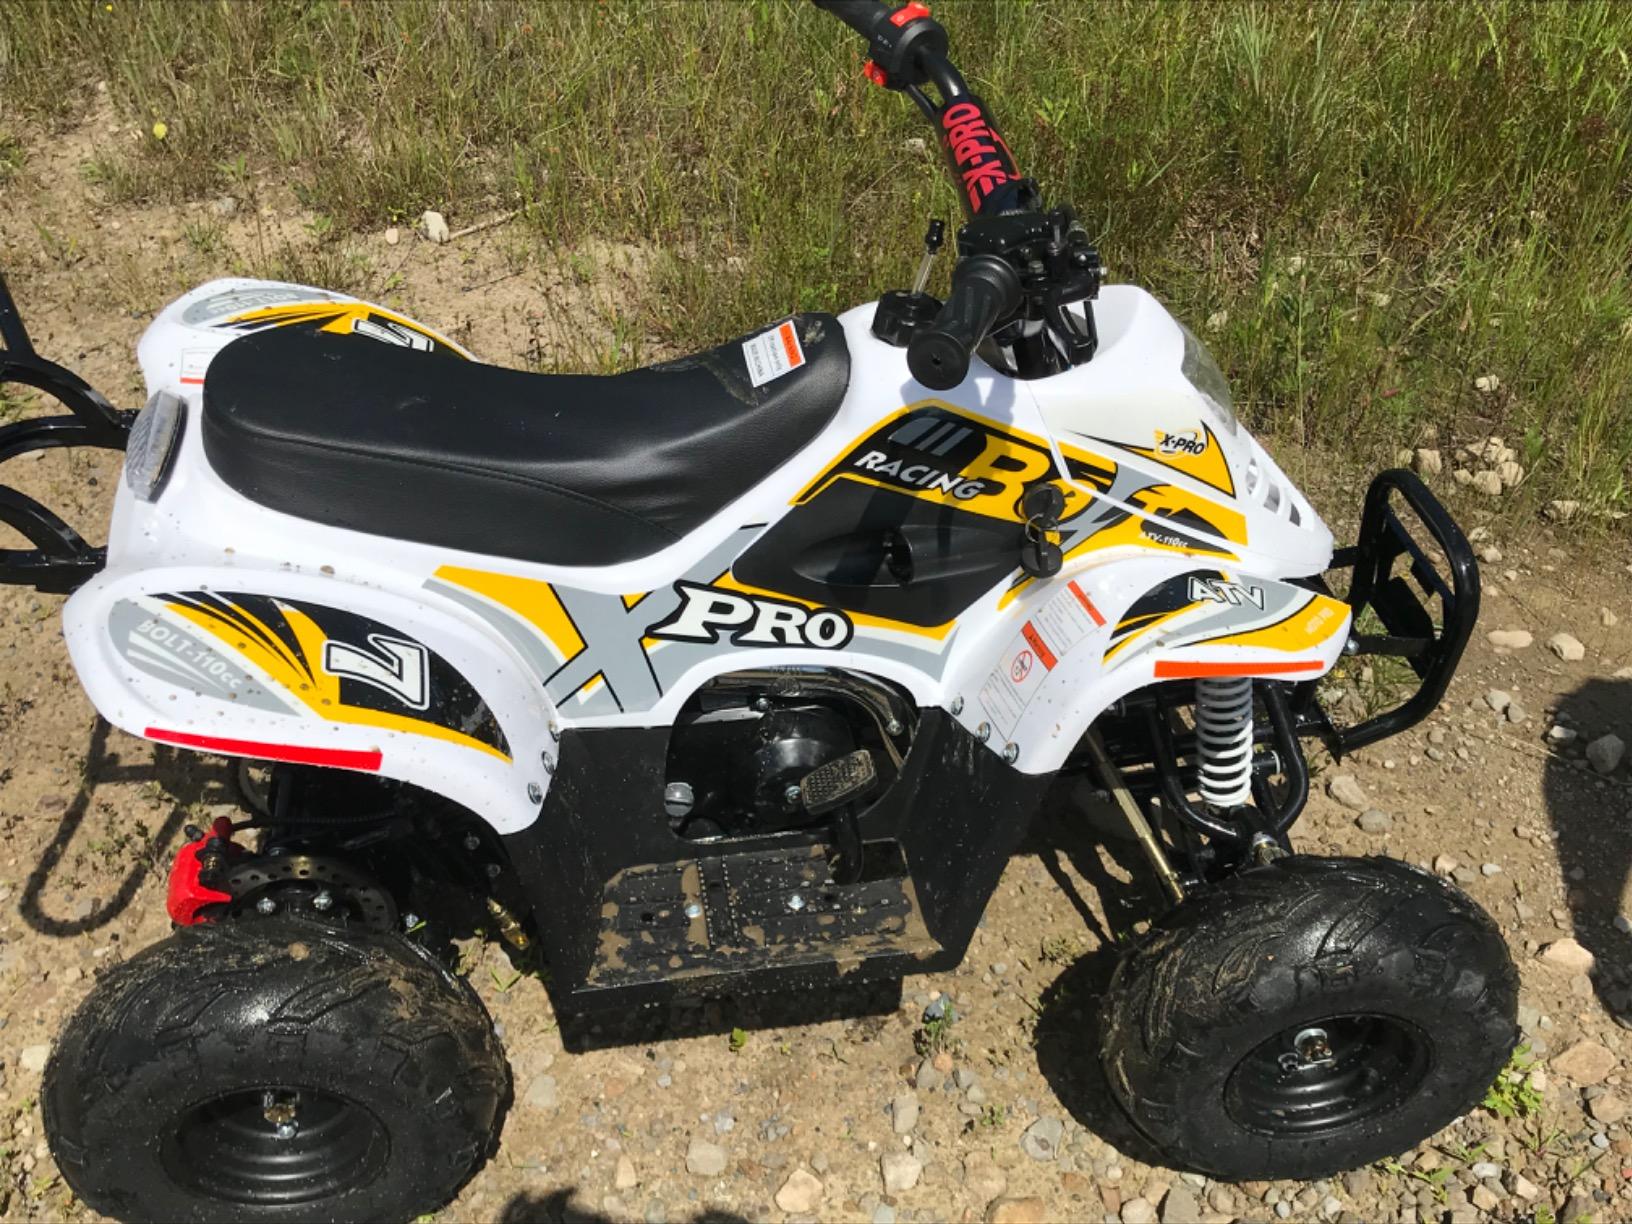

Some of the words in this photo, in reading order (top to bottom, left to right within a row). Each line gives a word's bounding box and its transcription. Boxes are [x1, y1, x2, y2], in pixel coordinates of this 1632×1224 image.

[942, 102, 1007, 194] X-PRO
[1160, 433, 1206, 456] X-PRO
[853, 450, 985, 500] RACING
[646, 582, 852, 649] PRO
[1188, 576, 1265, 611] ATV
[135, 619, 243, 690] BOLT-110cc
